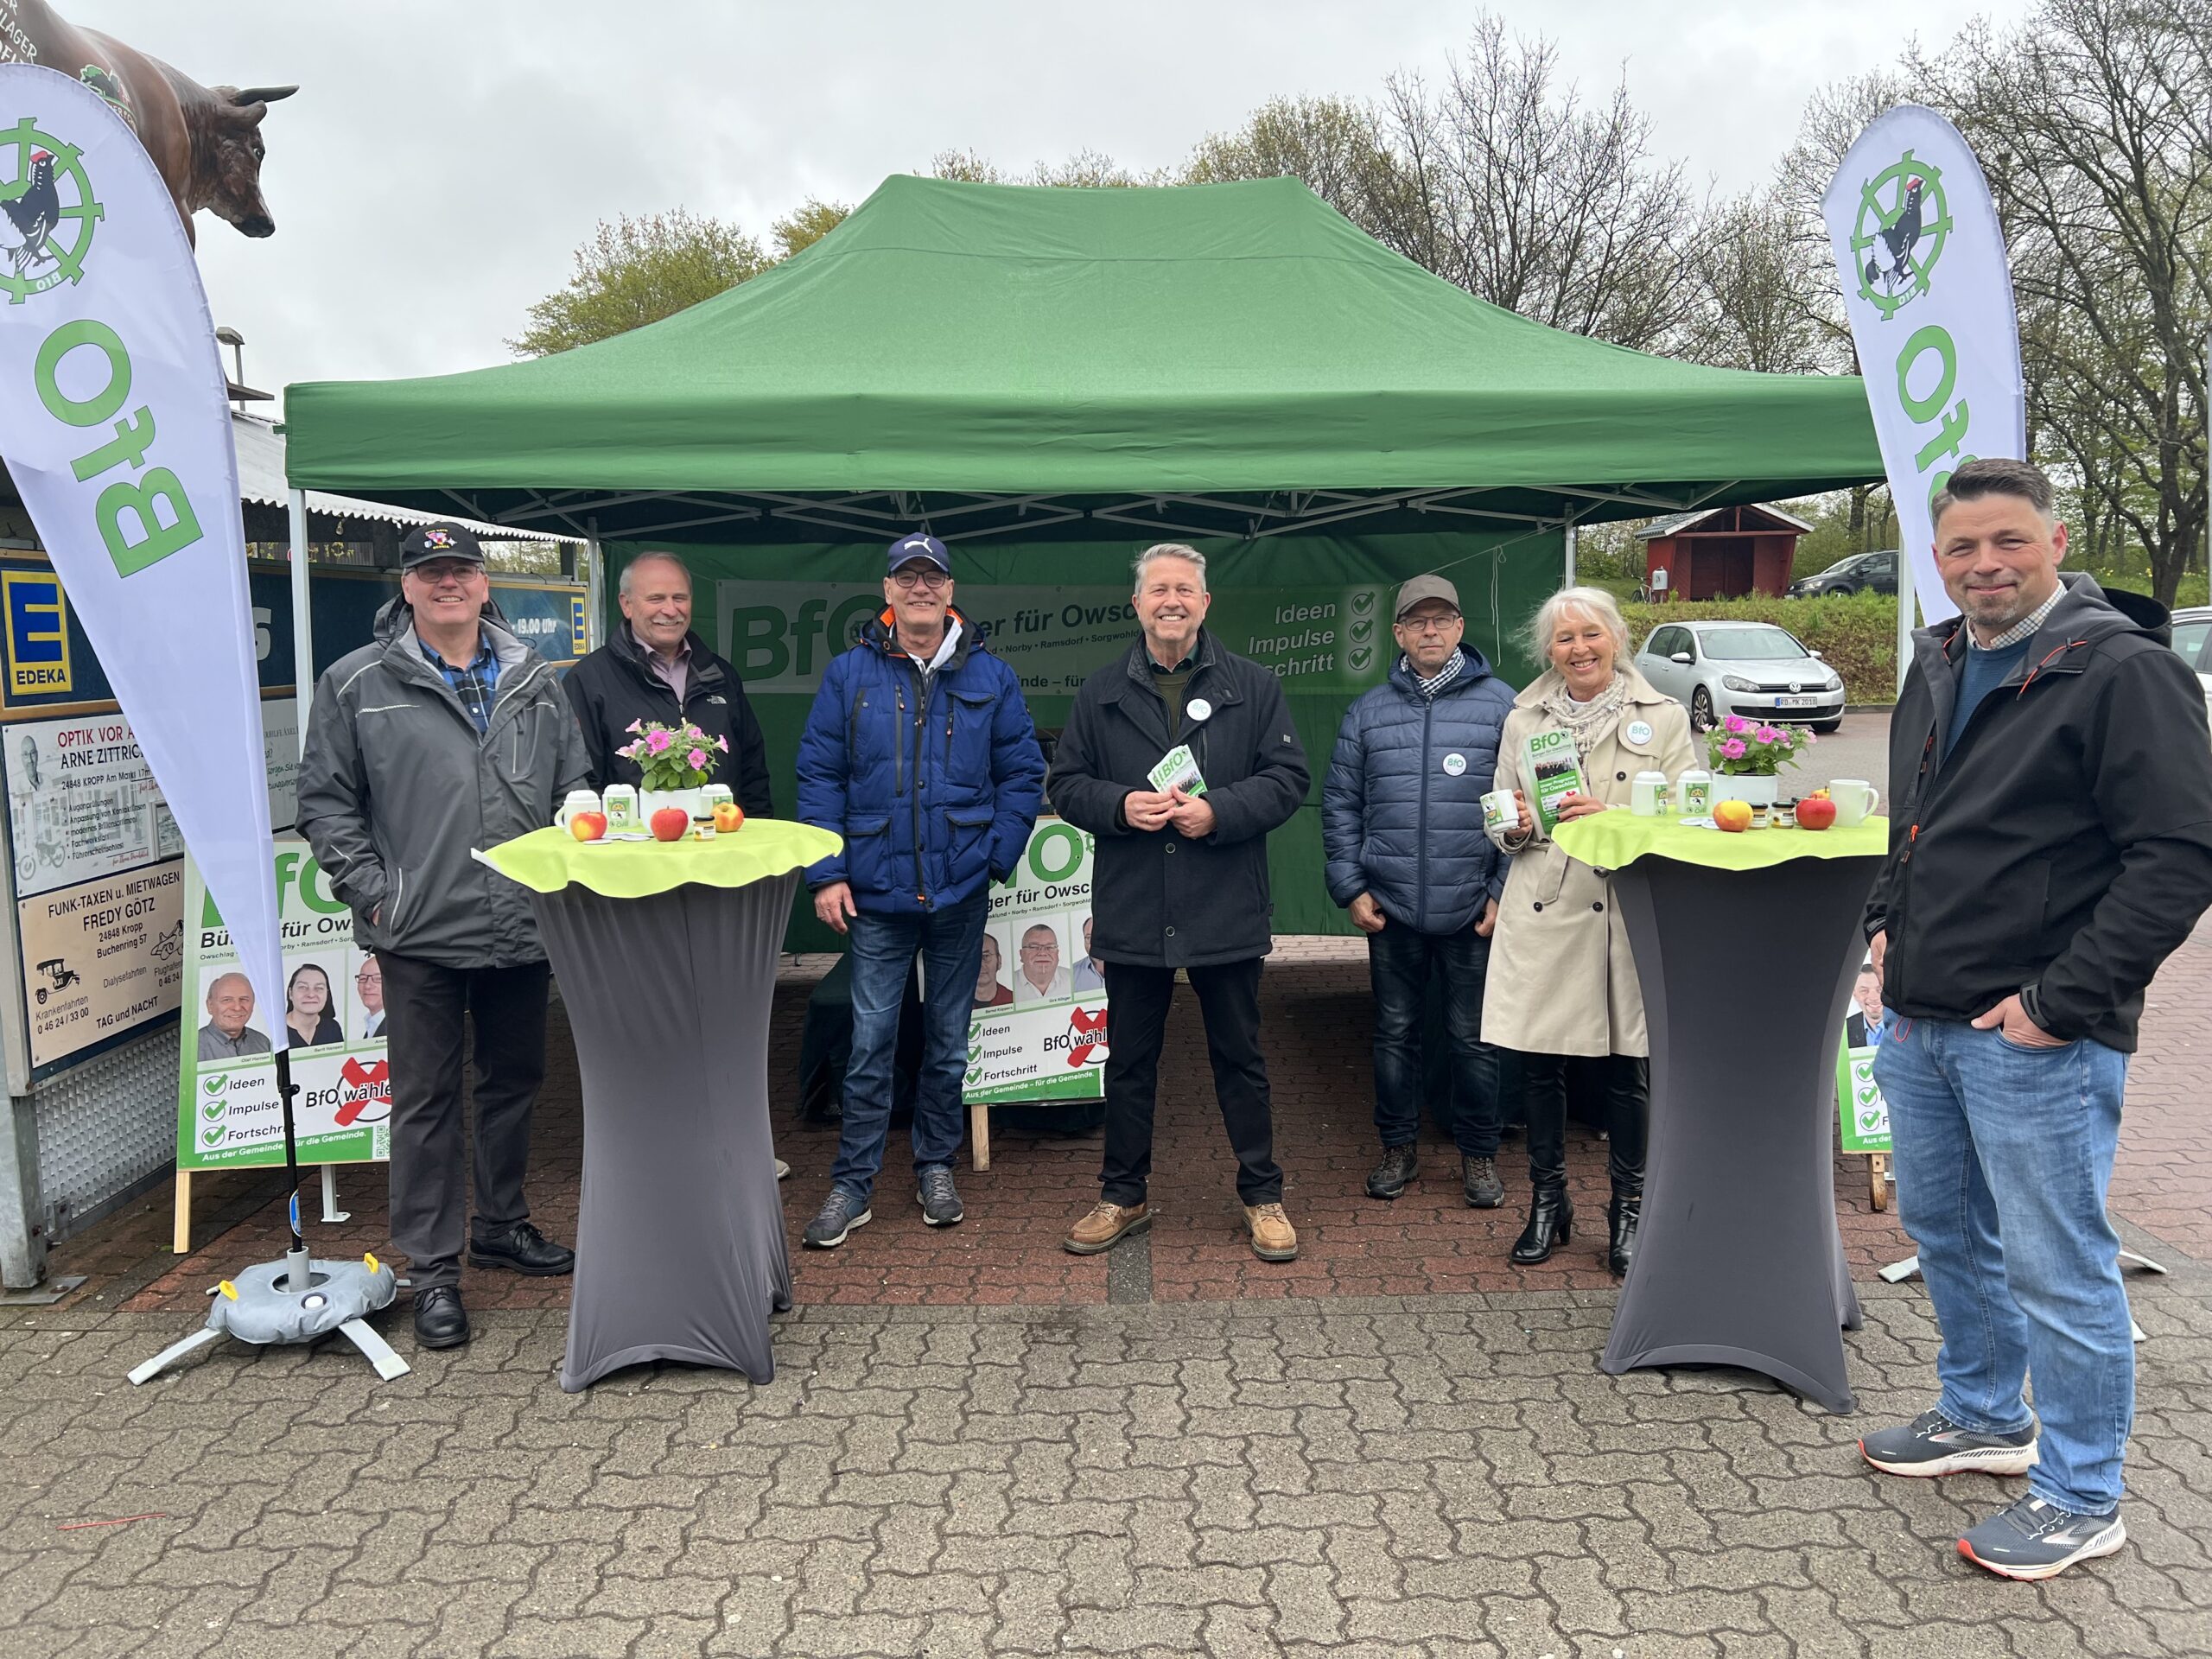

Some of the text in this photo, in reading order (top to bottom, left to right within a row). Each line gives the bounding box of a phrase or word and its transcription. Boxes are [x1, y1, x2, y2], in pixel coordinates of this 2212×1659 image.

[0, 8, 37, 64] LAGER
[1014, 609, 1053, 634] für
[1274, 602, 1336, 625] Ideen
[542, 618, 556, 633] Uhr
[1005, 643, 1033, 654] Norby
[1040, 636, 1084, 649] Ramsdorf
[1091, 629, 1140, 643] Sorgwohld
[1248, 628, 1335, 656] Impulse
[1258, 652, 1335, 677] schritt
[16, 669, 67, 685] EDEKA
[1017, 675, 1049, 688] inde
[1065, 674, 1085, 688] für
[58, 728, 94, 747] OPTIK
[99, 726, 123, 742] VOR
[1632, 726, 1650, 735] BfO
[1530, 732, 1560, 753] BfO
[60, 744, 144, 770] ARNE ZITTRIC
[1162, 753, 1183, 778] BfO
[1447, 758, 1464, 767] BfO
[83, 775, 105, 786] KROPP
[106, 774, 118, 783] Am
[48, 871, 180, 918] FUNK-TAXEN u. MIETWAGEN
[1016, 889, 1039, 905] für
[83, 898, 156, 931] FREDY GÖTZ
[1033, 903, 1058, 912] Ramsdorf
[1063, 898, 1091, 907] Sorgwohld
[99, 922, 143, 942] 24848 Kropp
[282, 922, 311, 938] für
[317, 918, 354, 933] Ow
[97, 934, 148, 958] Buchenring 57
[200, 951, 234, 961] Owschlag
[280, 944, 295, 952] orby
[302, 938, 334, 948] Ramsdorf
[104, 966, 147, 988] Dialysefahrten
[159, 978, 163, 987] 0
[35, 995, 89, 1021] Krankenfahrten
[97, 996, 158, 1029] TAG und NACHT
[37, 1025, 42, 1034] 0
[44, 1021, 54, 1032] 46
[55, 1017, 65, 1028] 24
[70, 1011, 79, 1022] 33
[80, 1007, 89, 1018] 00
[982, 1026, 1010, 1037] Ideen
[983, 1046, 1023, 1059] Impulse
[1044, 1035, 1070, 1052] BfO
[984, 1064, 1037, 1080] Fortschritt
[229, 1077, 264, 1090] Ideen
[965, 1090, 979, 1099] Aus
[980, 1089, 993, 1097] der
[994, 1084, 1028, 1094] Gemeinde
[1035, 1077, 1046, 1087] für
[1046, 1075, 1057, 1084] die
[1058, 1071, 1095, 1082] Gemeinde.
[228, 1100, 279, 1116] Impulse
[305, 1089, 339, 1108] BfO
[227, 1122, 296, 1141] Fortschr
[1863, 1135, 1877, 1145] Aus
[202, 1130, 366, 1162] Aus der Gemeinde ür die Gemeinde.
